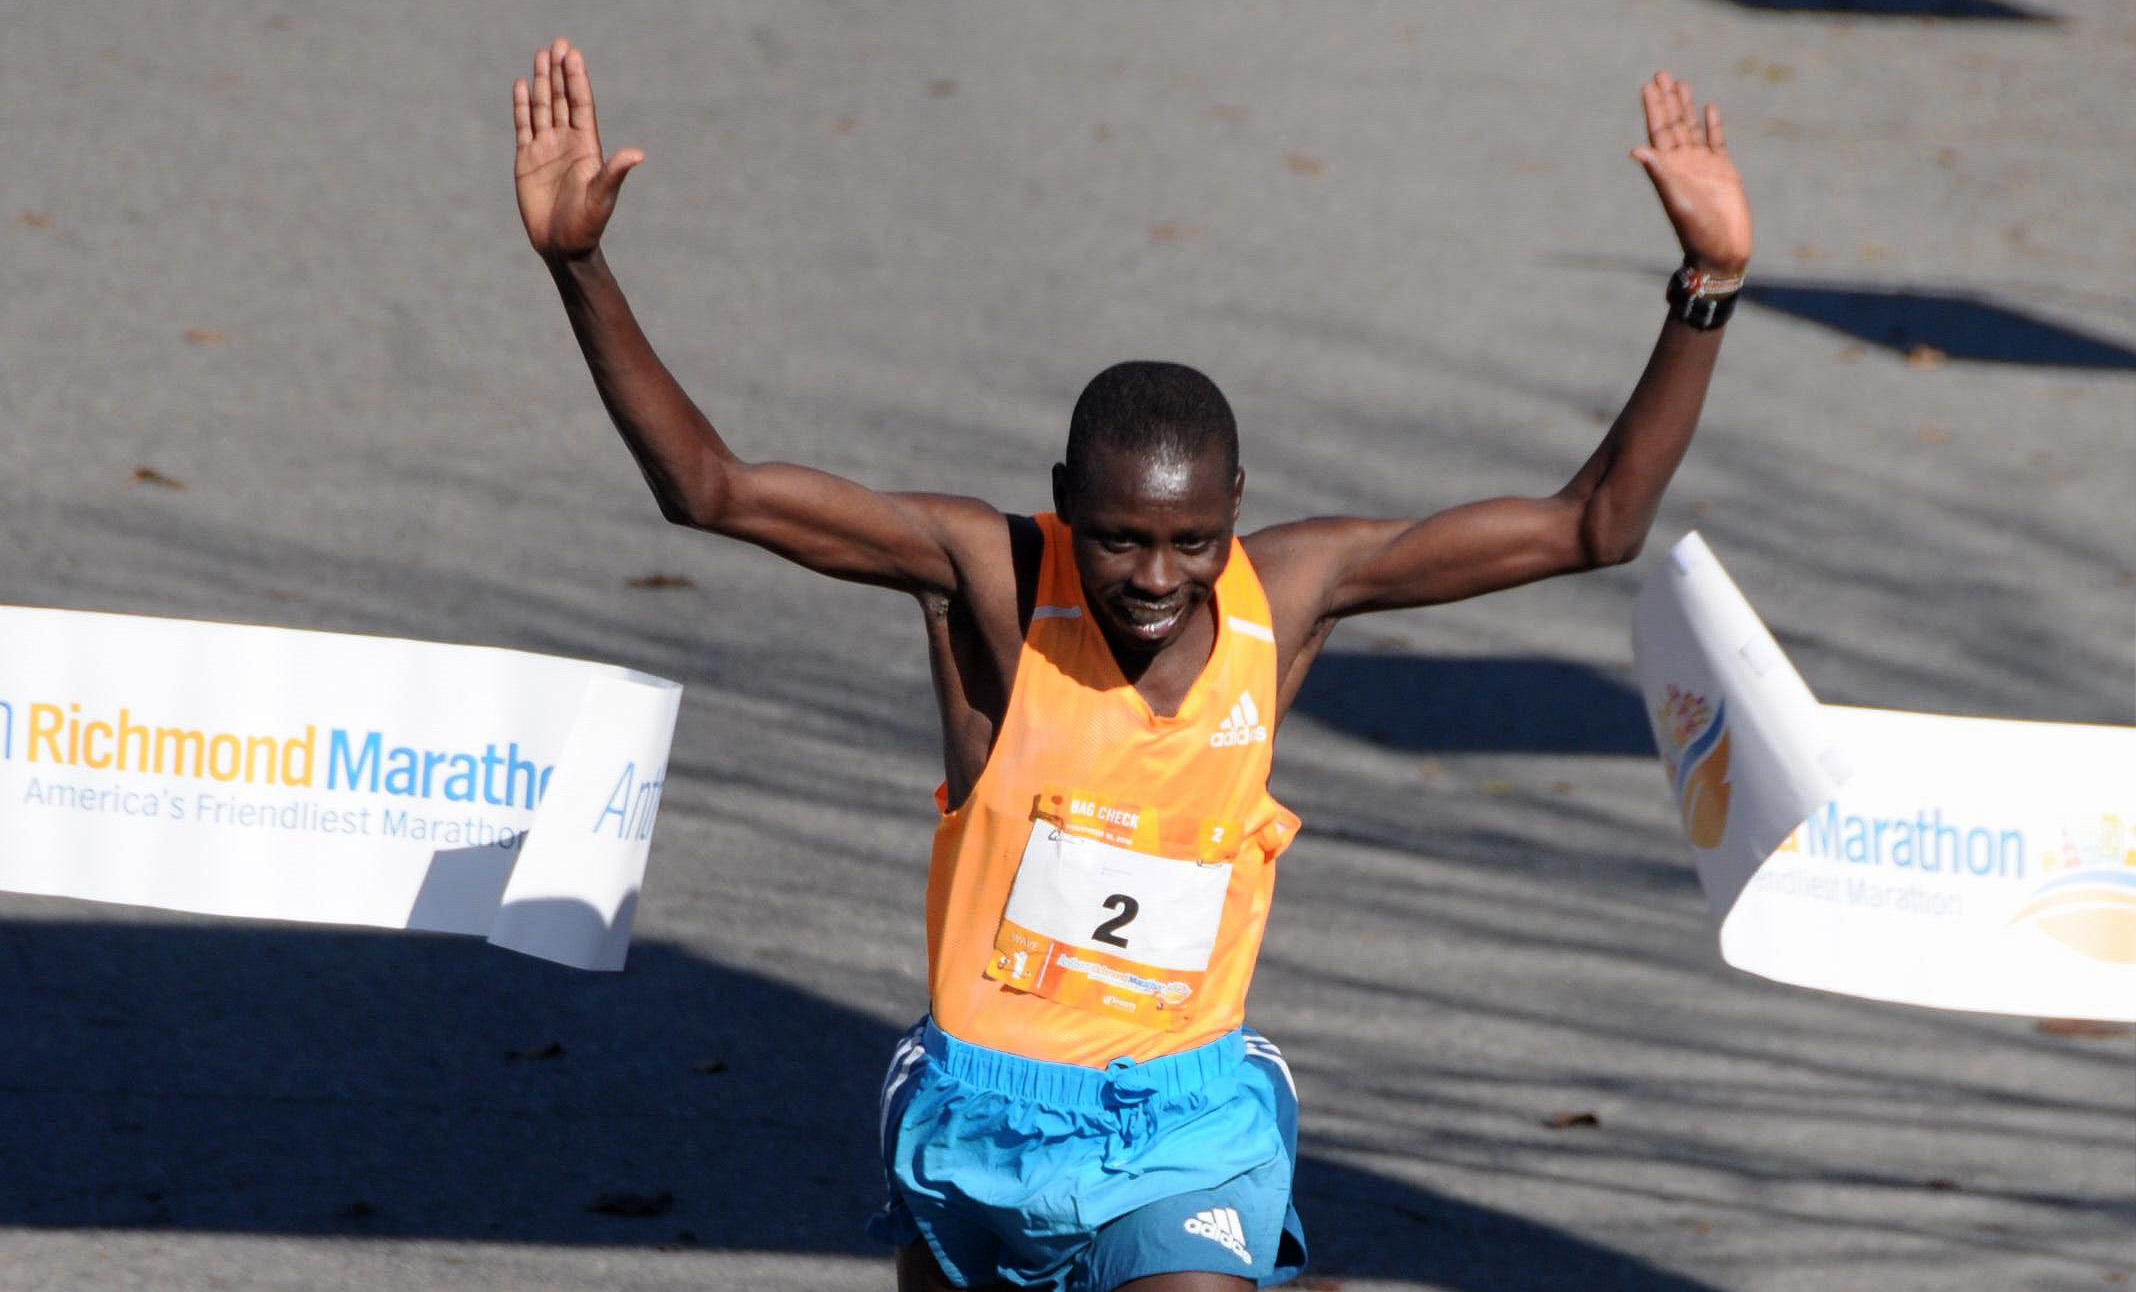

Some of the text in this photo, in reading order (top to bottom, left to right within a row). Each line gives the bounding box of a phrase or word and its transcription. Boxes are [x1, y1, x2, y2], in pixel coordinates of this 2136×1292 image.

[26, 701, 317, 788] Richmond
[1209, 724, 1268, 749] adidas
[22, 776, 185, 821] America's
[195, 792, 371, 836] Friendliest
[1070, 798, 1140, 829] BAG CHECK
[1210, 826, 1225, 844] 2
[1807, 800, 2026, 879] Marathon
[1090, 893, 1140, 949] 2
[1012, 950, 1029, 980] 1
[1184, 1217, 1253, 1266] adidas
